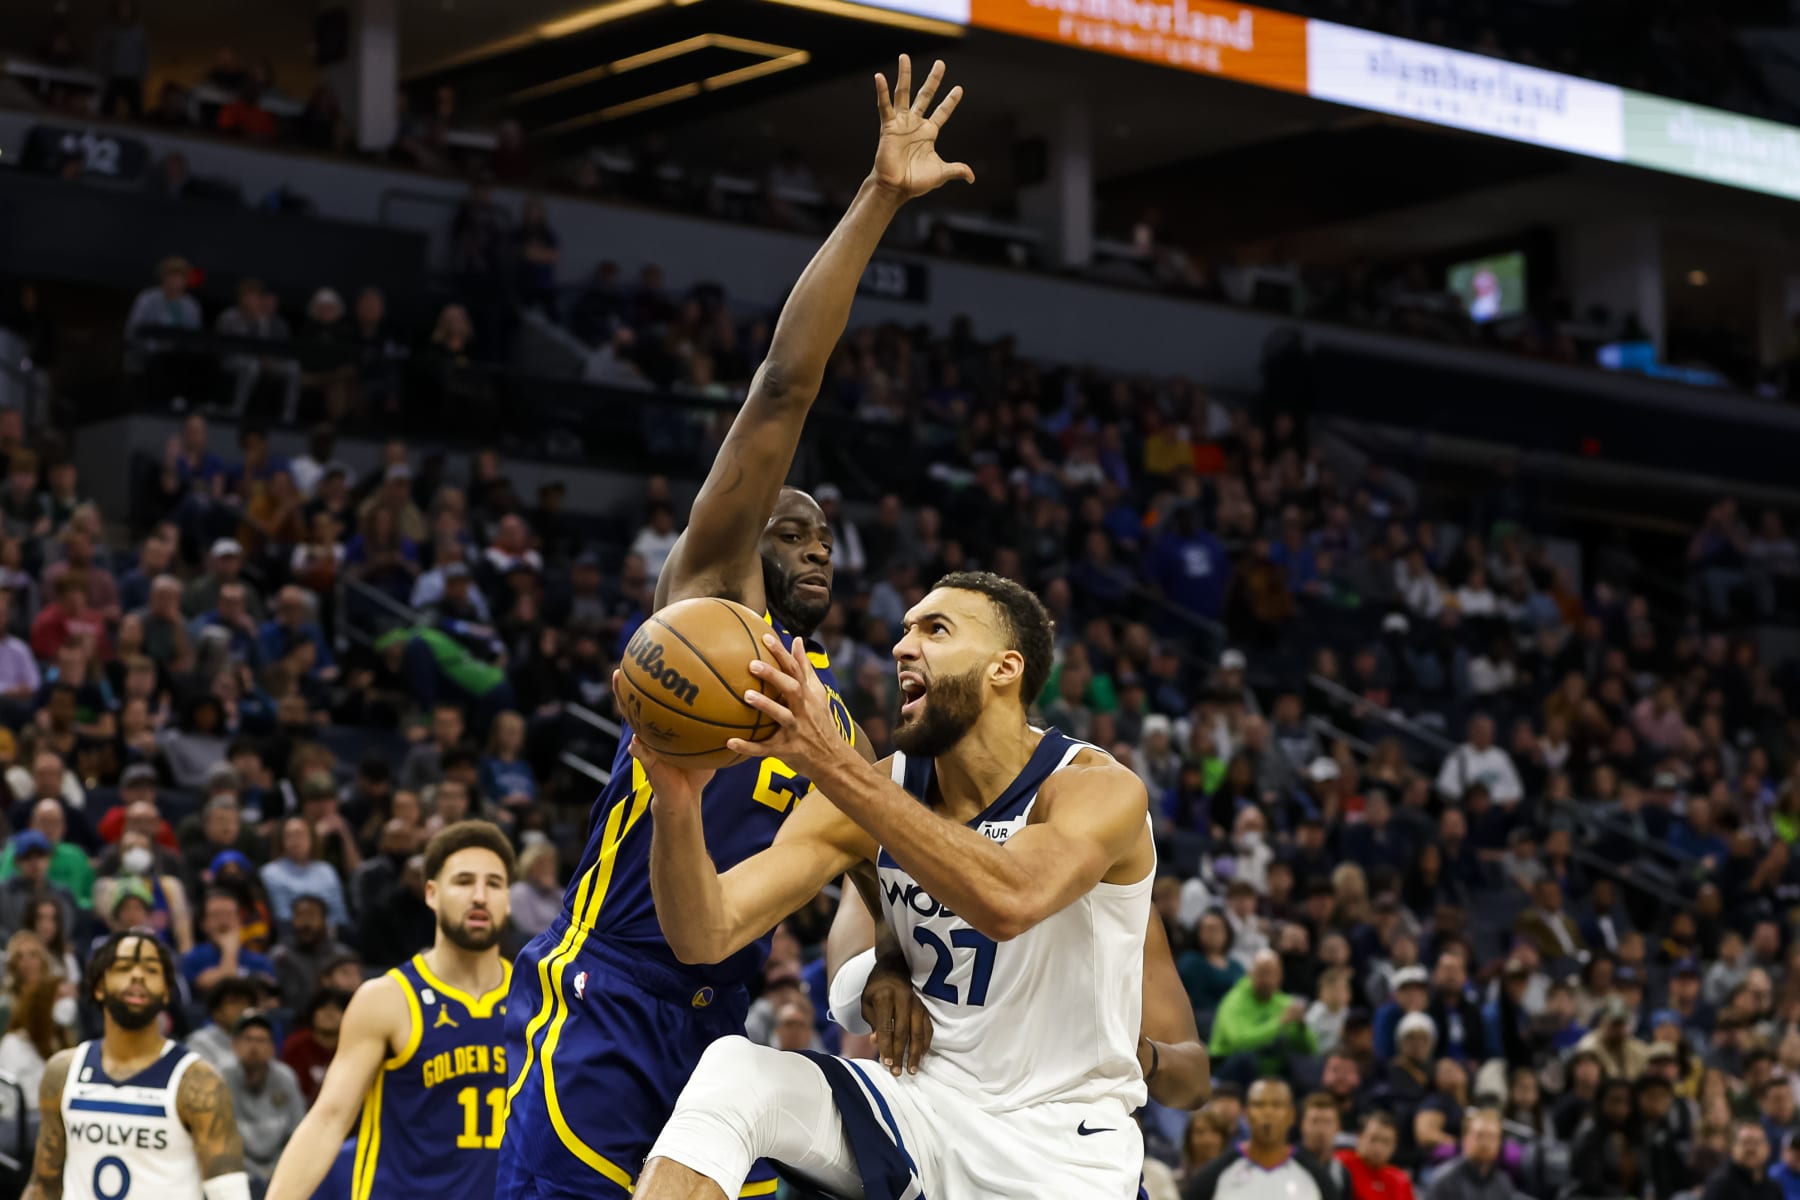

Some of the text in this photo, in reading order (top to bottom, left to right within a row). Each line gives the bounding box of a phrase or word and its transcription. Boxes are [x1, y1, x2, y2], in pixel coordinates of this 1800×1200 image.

[627, 626, 699, 707] Wilson
[913, 926, 998, 1007] 27
[422, 1044, 490, 1089] GOLDEN
[68, 1122, 168, 1150] WOLVES
[456, 1086, 507, 1150] 11
[93, 1155, 131, 1200] 0
